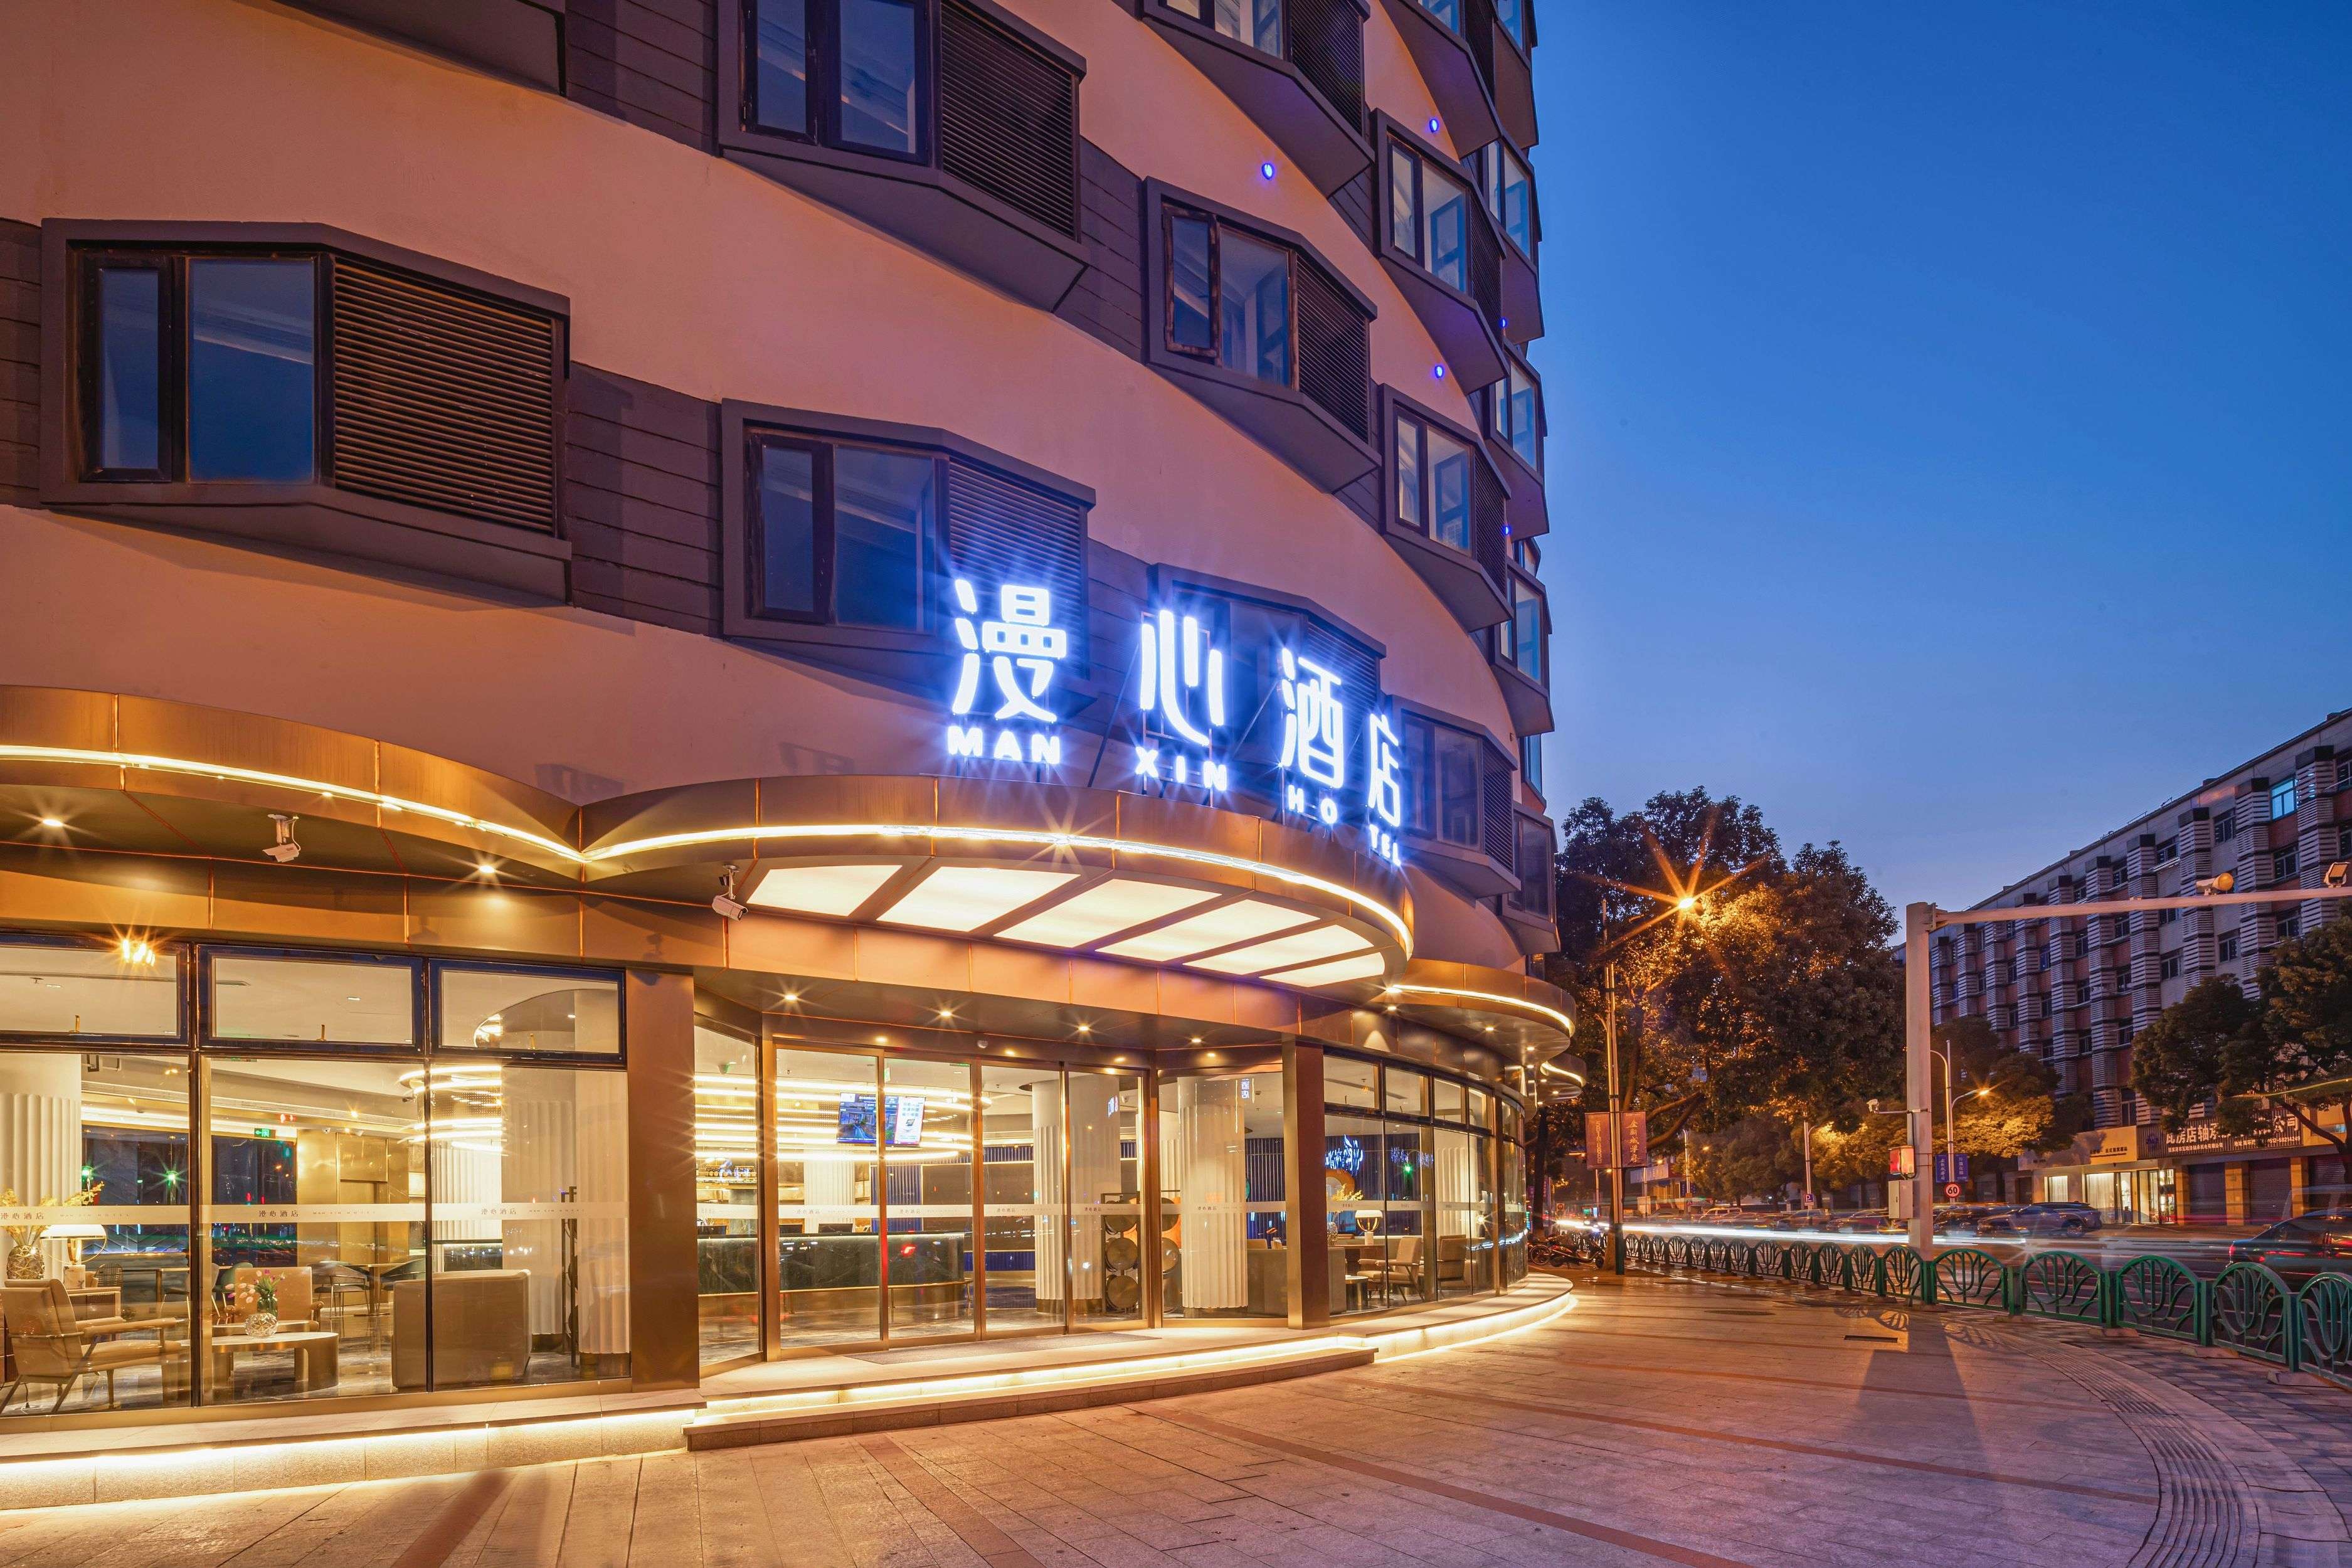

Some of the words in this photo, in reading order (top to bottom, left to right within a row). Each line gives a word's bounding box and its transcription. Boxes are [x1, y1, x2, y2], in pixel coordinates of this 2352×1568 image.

[948, 726, 1061, 765] MAN
[1135, 746, 1228, 792] XIN
[952, 578, 1401, 828] 漫心酒店
